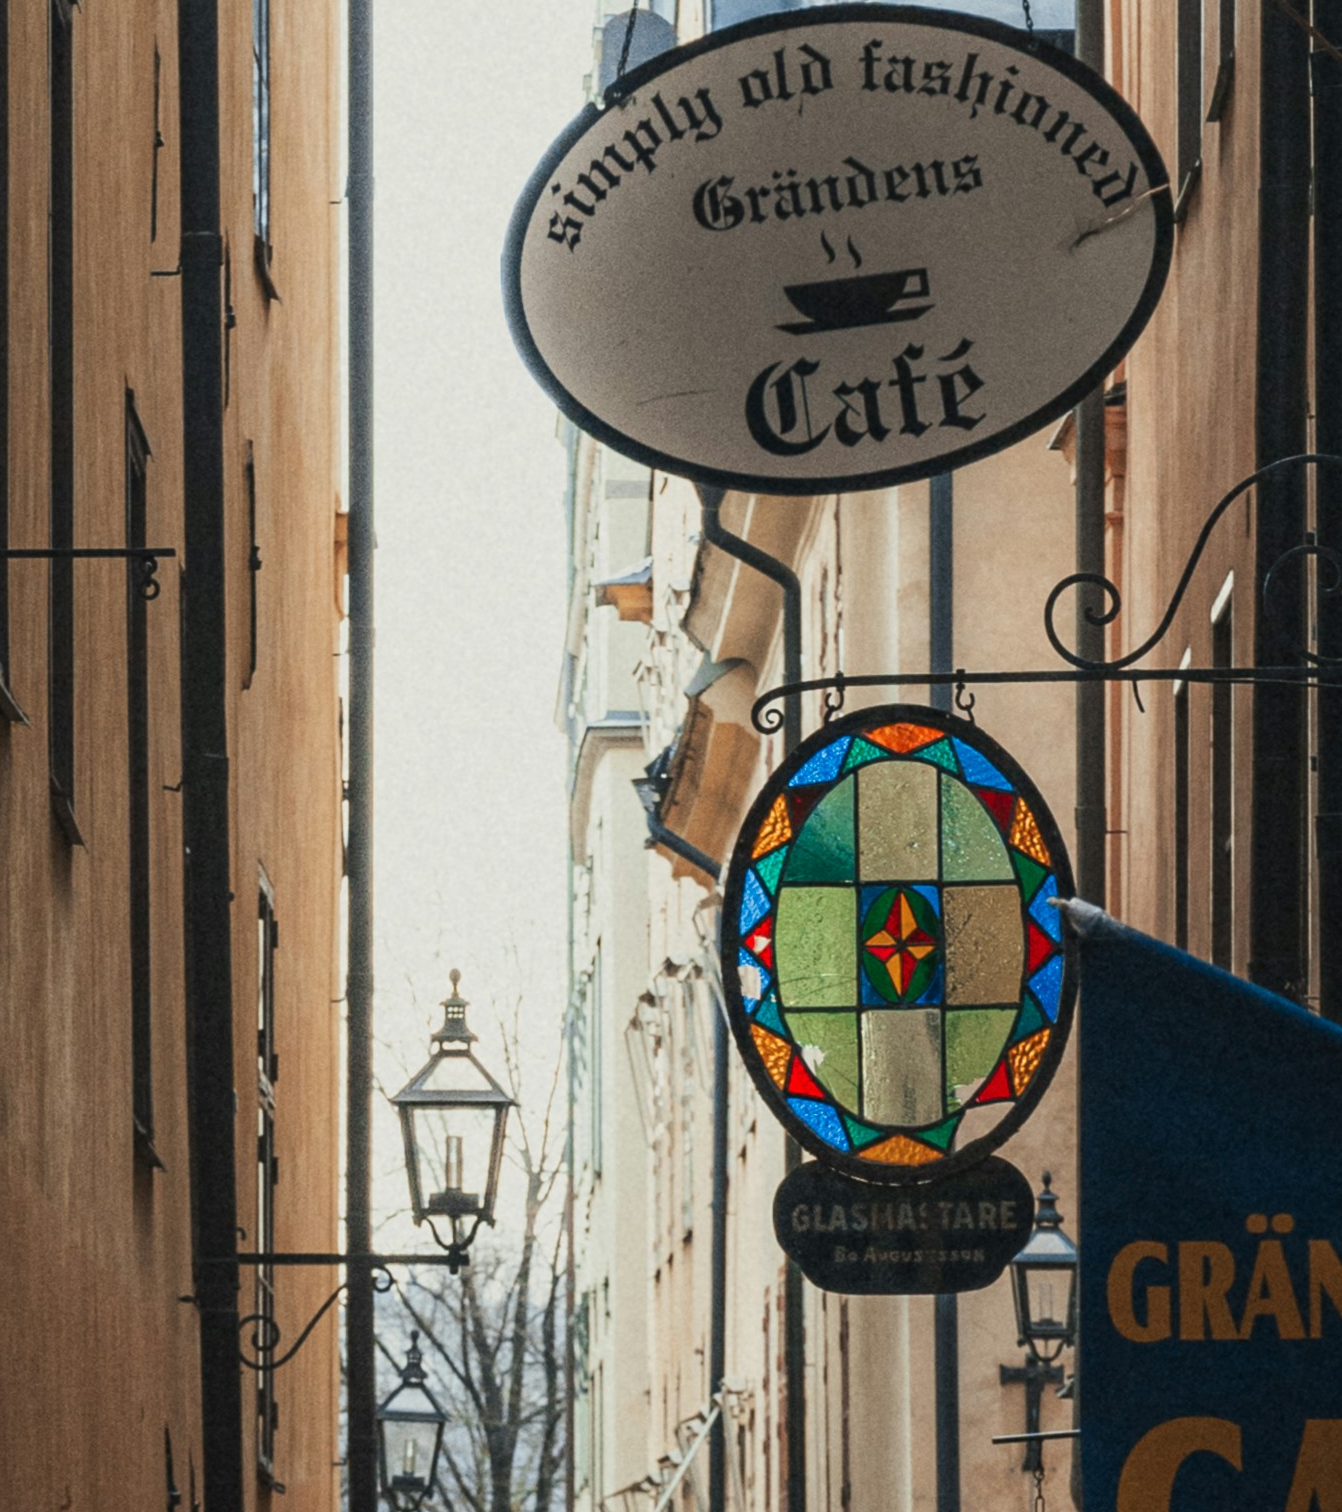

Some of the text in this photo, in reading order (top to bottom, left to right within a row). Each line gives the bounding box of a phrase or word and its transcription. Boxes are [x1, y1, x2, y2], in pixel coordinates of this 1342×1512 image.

[547, 38, 1139, 254] simply old fashioned
[692, 153, 985, 233] Grändens
[745, 338, 989, 458] Café
